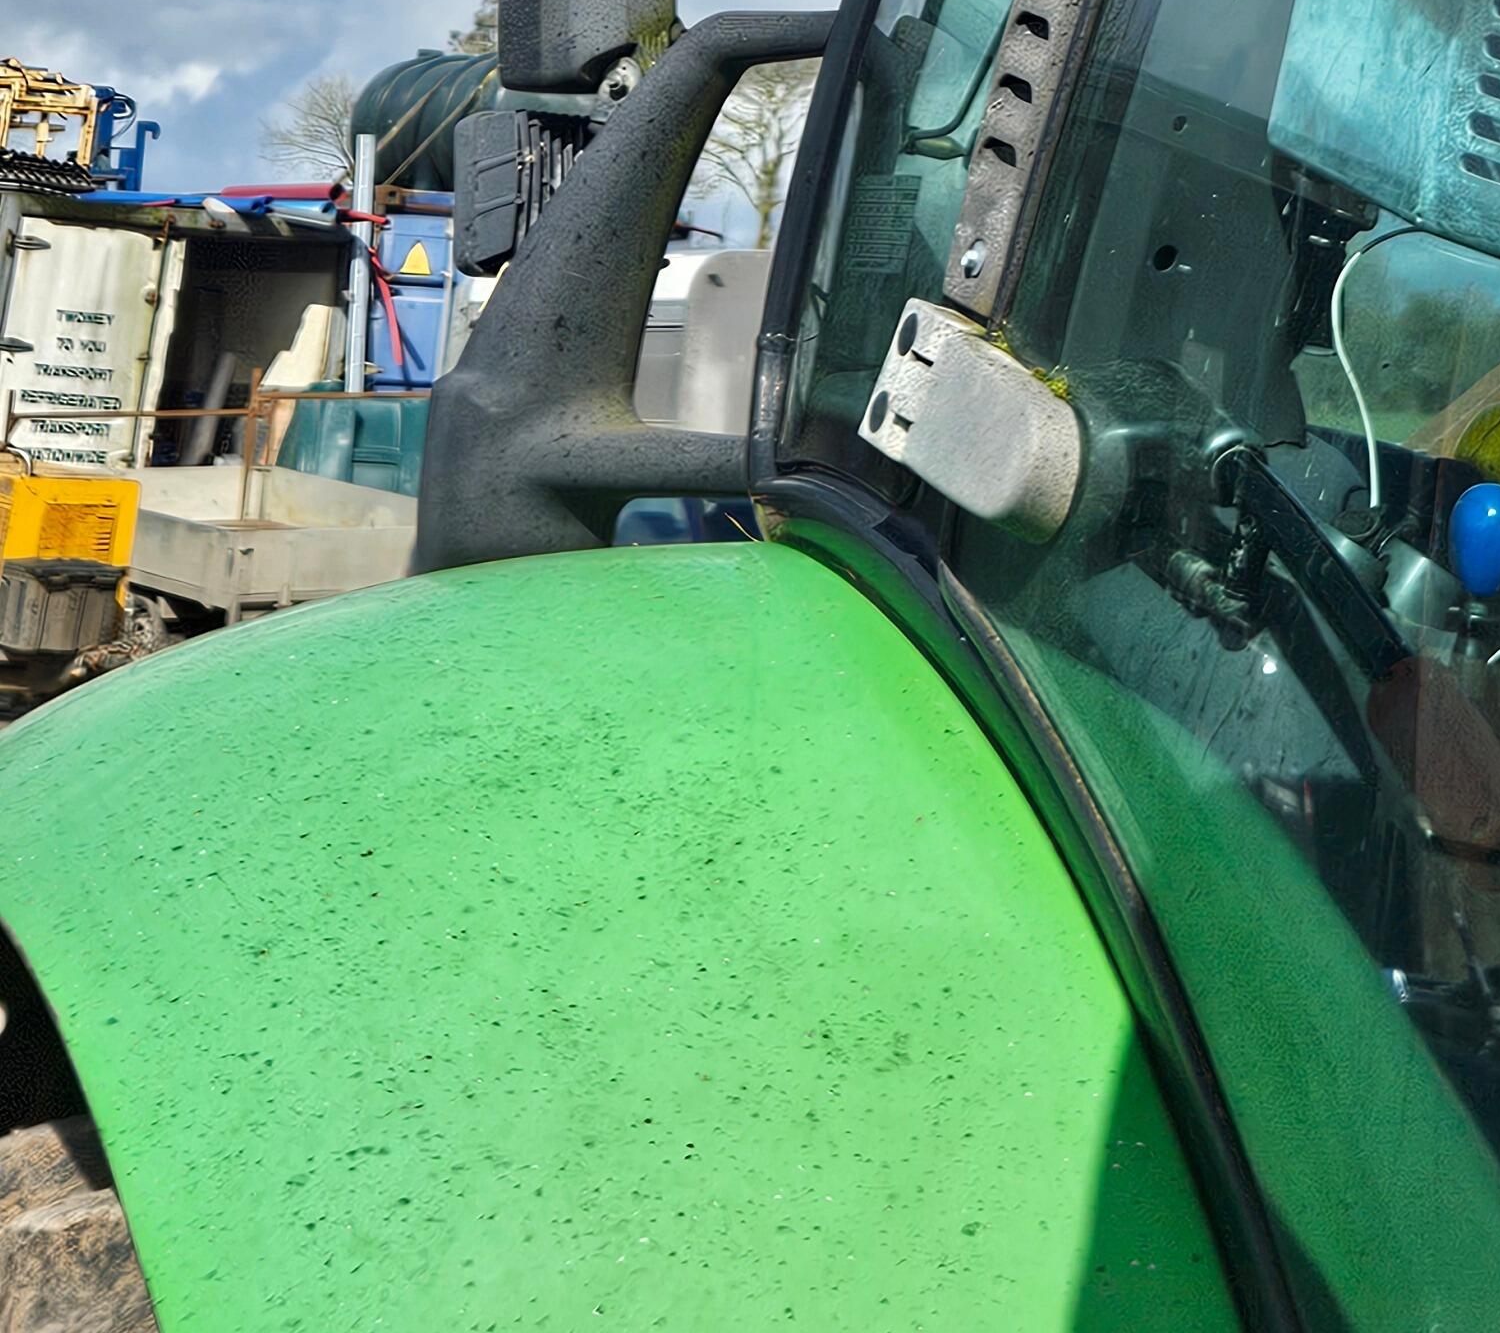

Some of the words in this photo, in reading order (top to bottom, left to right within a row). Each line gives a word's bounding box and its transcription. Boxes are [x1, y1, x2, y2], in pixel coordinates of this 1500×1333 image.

[34, 363, 115, 381] TRANSPORT
[20, 389, 122, 410] REFRIGERATED
[30, 419, 111, 437] TRANSPORT
